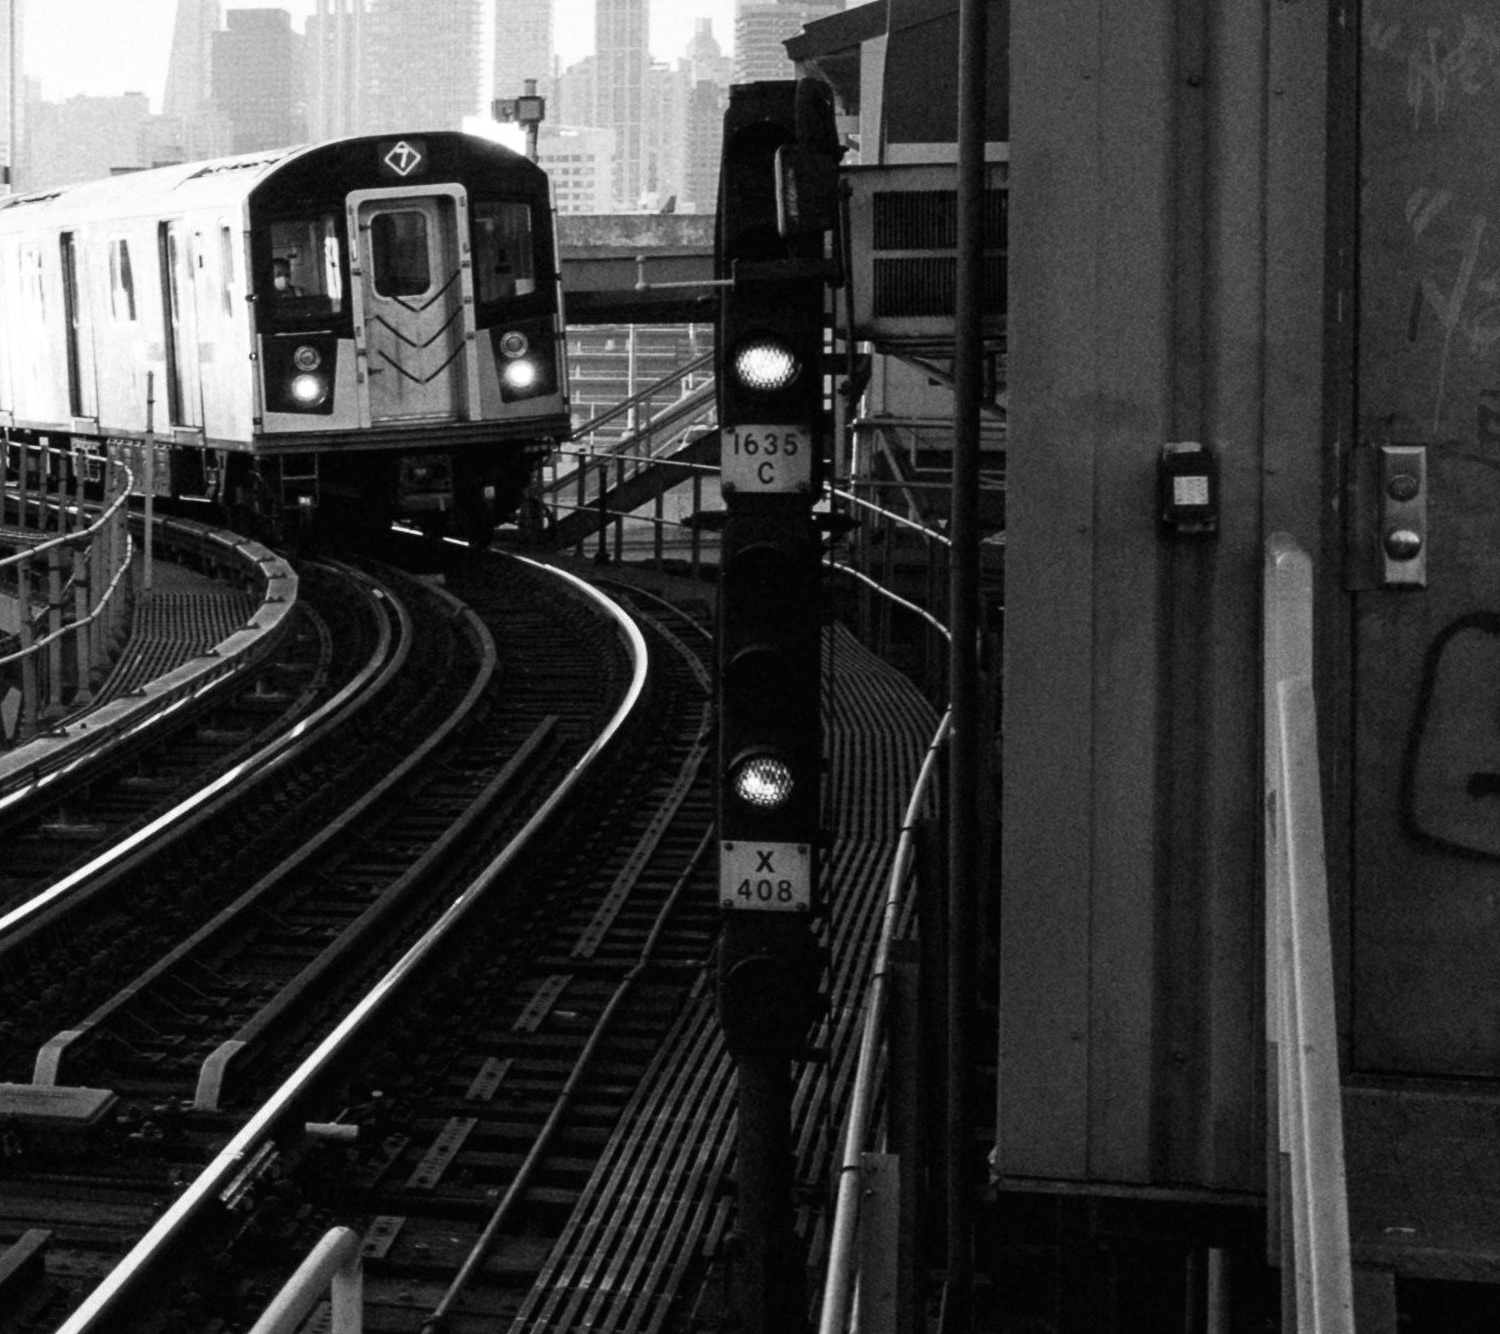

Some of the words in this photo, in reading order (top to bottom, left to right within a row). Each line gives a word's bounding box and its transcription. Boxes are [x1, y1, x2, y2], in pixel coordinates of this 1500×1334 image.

[395, 148, 409, 168] 7
[734, 432, 799, 456] 1635
[757, 461, 775, 485] C
[755, 850, 776, 873] X
[737, 878, 793, 903] 408
